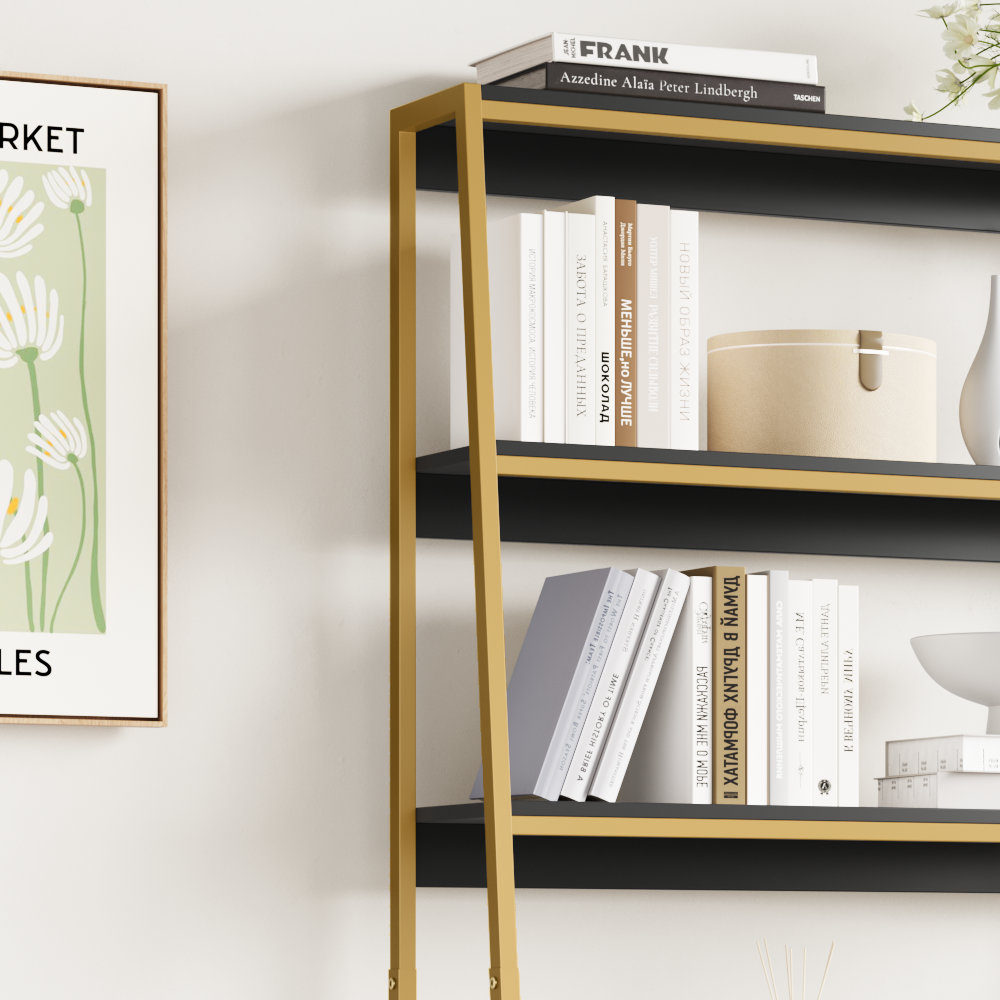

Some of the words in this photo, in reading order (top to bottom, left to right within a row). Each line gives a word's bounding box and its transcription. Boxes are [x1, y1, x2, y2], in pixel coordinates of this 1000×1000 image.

[580, 40, 669, 64] FRANK
[560, 72, 618, 87] Azzedine
[621, 76, 654, 90] Alaïa
[659, 80, 690, 93] Peter
[694, 82, 758, 102] Lindbergh
[793, 94, 820, 102] TASCHEN
[0, 122, 84, 154] RKET
[576, 254, 587, 307] ЗАБОТА
[680, 242, 691, 301] НОВЫЙ
[577, 313, 586, 323] О
[680, 306, 691, 356] ОБРАЗ
[576, 328, 587, 417] ПРЕДАННЫХ
[600, 352, 610, 424] ШОКОЛАД
[680, 362, 691, 422] ЖИЗНИ
[620, 378, 633, 427] ЛУЧШЕ
[0, 649, 52, 676] LES
